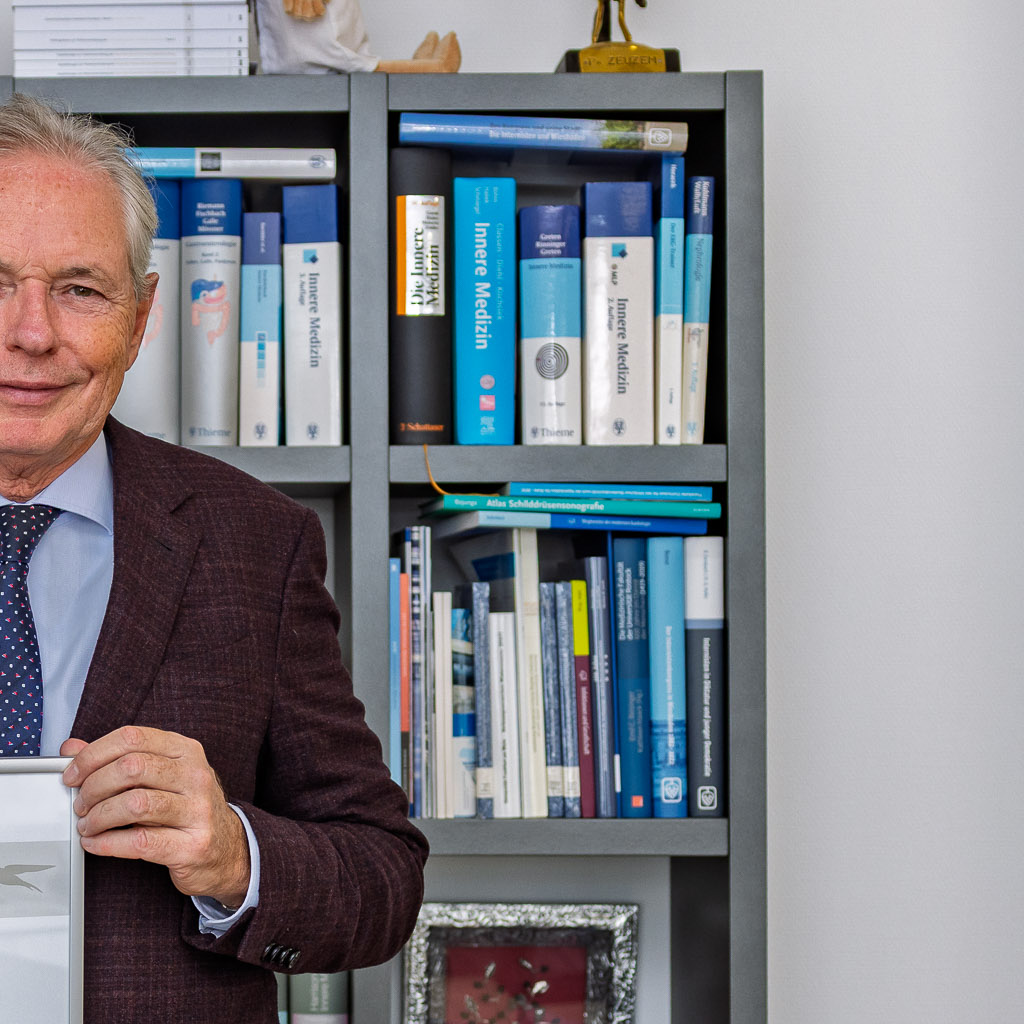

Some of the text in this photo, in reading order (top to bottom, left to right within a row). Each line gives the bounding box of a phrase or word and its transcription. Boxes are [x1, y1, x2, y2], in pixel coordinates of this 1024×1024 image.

[410, 227, 425, 306] Die Innere
[425, 244, 439, 306] Medizin
[475, 222, 492, 350] Innere Medizin
[308, 272, 322, 368] Innere Medizin
[607, 305, 615, 332] Auflage
[616, 298, 629, 395] Innere Medizin
[198, 427, 231, 437] Thieme
[541, 428, 574, 437] Thieme
[617, 561, 625, 588] Fakultät
[625, 567, 633, 594] Rostock
[618, 588, 626, 629] Medizinische
[625, 593, 633, 629] Universität
[702, 638, 712, 778] Internisten in Diktatur und junger Demokratie
